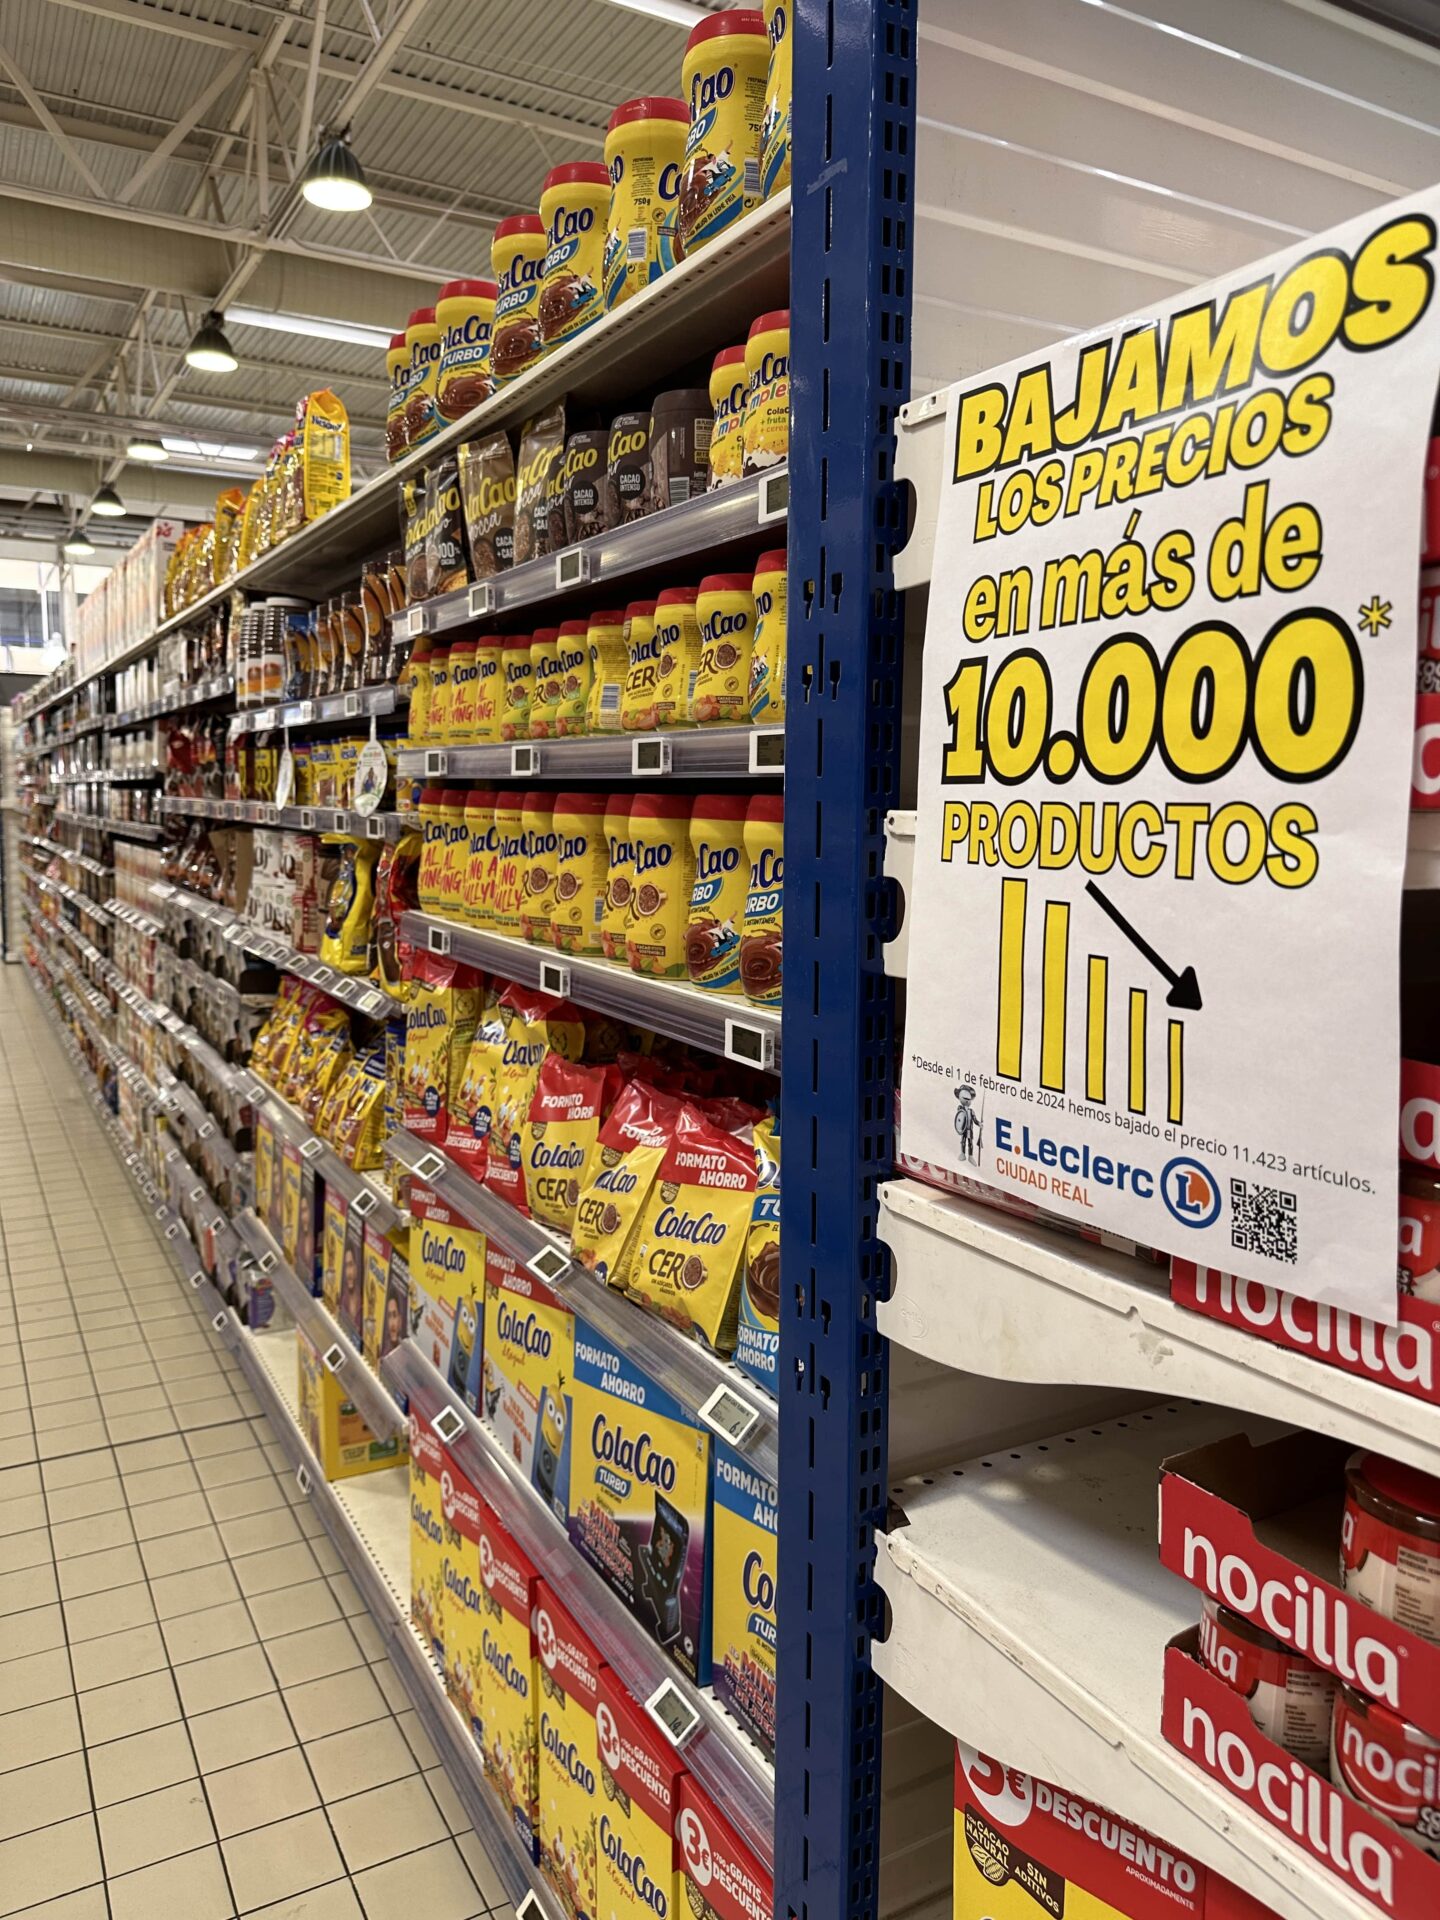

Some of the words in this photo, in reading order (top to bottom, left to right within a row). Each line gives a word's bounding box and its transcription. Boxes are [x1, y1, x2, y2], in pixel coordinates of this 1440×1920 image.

[442, 347, 482, 368] TURBO
[952, 214, 1437, 483] BAJAMOS
[750, 382, 788, 410] mple
[619, 474, 640, 484] CACAO
[973, 459, 1065, 543] LOS
[1063, 371, 1335, 519] PRECIOS
[574, 489, 594, 500] CACAO
[962, 565, 1032, 642] en
[1039, 508, 1195, 630] más
[1207, 480, 1323, 602] de
[941, 800, 1319, 889] PRODUCTOS
[692, 884, 714, 901] RBO
[945, 1065, 954, 1080] el
[956, 1067, 962, 1080] 1
[964, 1070, 977, 1085] de
[979, 1074, 1018, 1097] febrero
[1020, 1086, 1034, 1102] de
[1036, 1091, 1066, 1112] 2024
[1068, 1099, 1112, 1125] hemos
[1114, 1111, 1160, 1139] bajado
[1164, 1126, 1177, 1143] el
[1180, 1132, 1228, 1157] precio
[1233, 1145, 1288, 1172] 11.423
[1292, 1163, 1376, 1195] artículos.
[675, 1151, 726, 1170] FORMATO
[995, 1117, 1155, 1199] E.Leclerc
[699, 1172, 747, 1190] AHORRO
[996, 1157, 1048, 1191] CIUDAD
[1052, 1178, 1095, 1209] REAL
[654, 1206, 726, 1245] ColaCao
[422, 1230, 466, 1273] ColaCao
[502, 1273, 532, 1297] AHORRO
[497, 1301, 551, 1358] ColaCao
[575, 1341, 620, 1373] FORMATO
[736, 1350, 776, 1373] AHORRO
[601, 1371, 646, 1405] AHORRO
[591, 1413, 676, 1492] ColaCao
[599, 1469, 628, 1495] TURBO
[716, 1457, 778, 1501] FORMATO
[754, 1617, 776, 1645] TUR
[1183, 1526, 1401, 1708] nocilla
[482, 1627, 528, 1698] ColaCao
[557, 1647, 597, 1692] DESCUENTO
[540, 1711, 596, 1797] ColaCao
[620, 1746, 671, 1805] DESCUENTO
[632, 1746, 661, 1777] GRATIS
[1343, 1719, 1440, 1802] noci
[1183, 1696, 1395, 1906] nocilla
[966, 1820, 1009, 1869] NATURAL
[977, 1821, 1009, 1856] CACAO
[1035, 1782, 1196, 1893] DESCUENTO
[600, 1815, 667, 1919] ColaCao
[730, 1862, 762, 1903] GRATIS
[1014, 1866, 1060, 1913] ADITIVOS
[1027, 1862, 1047, 1889] SIN
[1125, 1865, 1195, 1911] APROXIMADAMENTE
